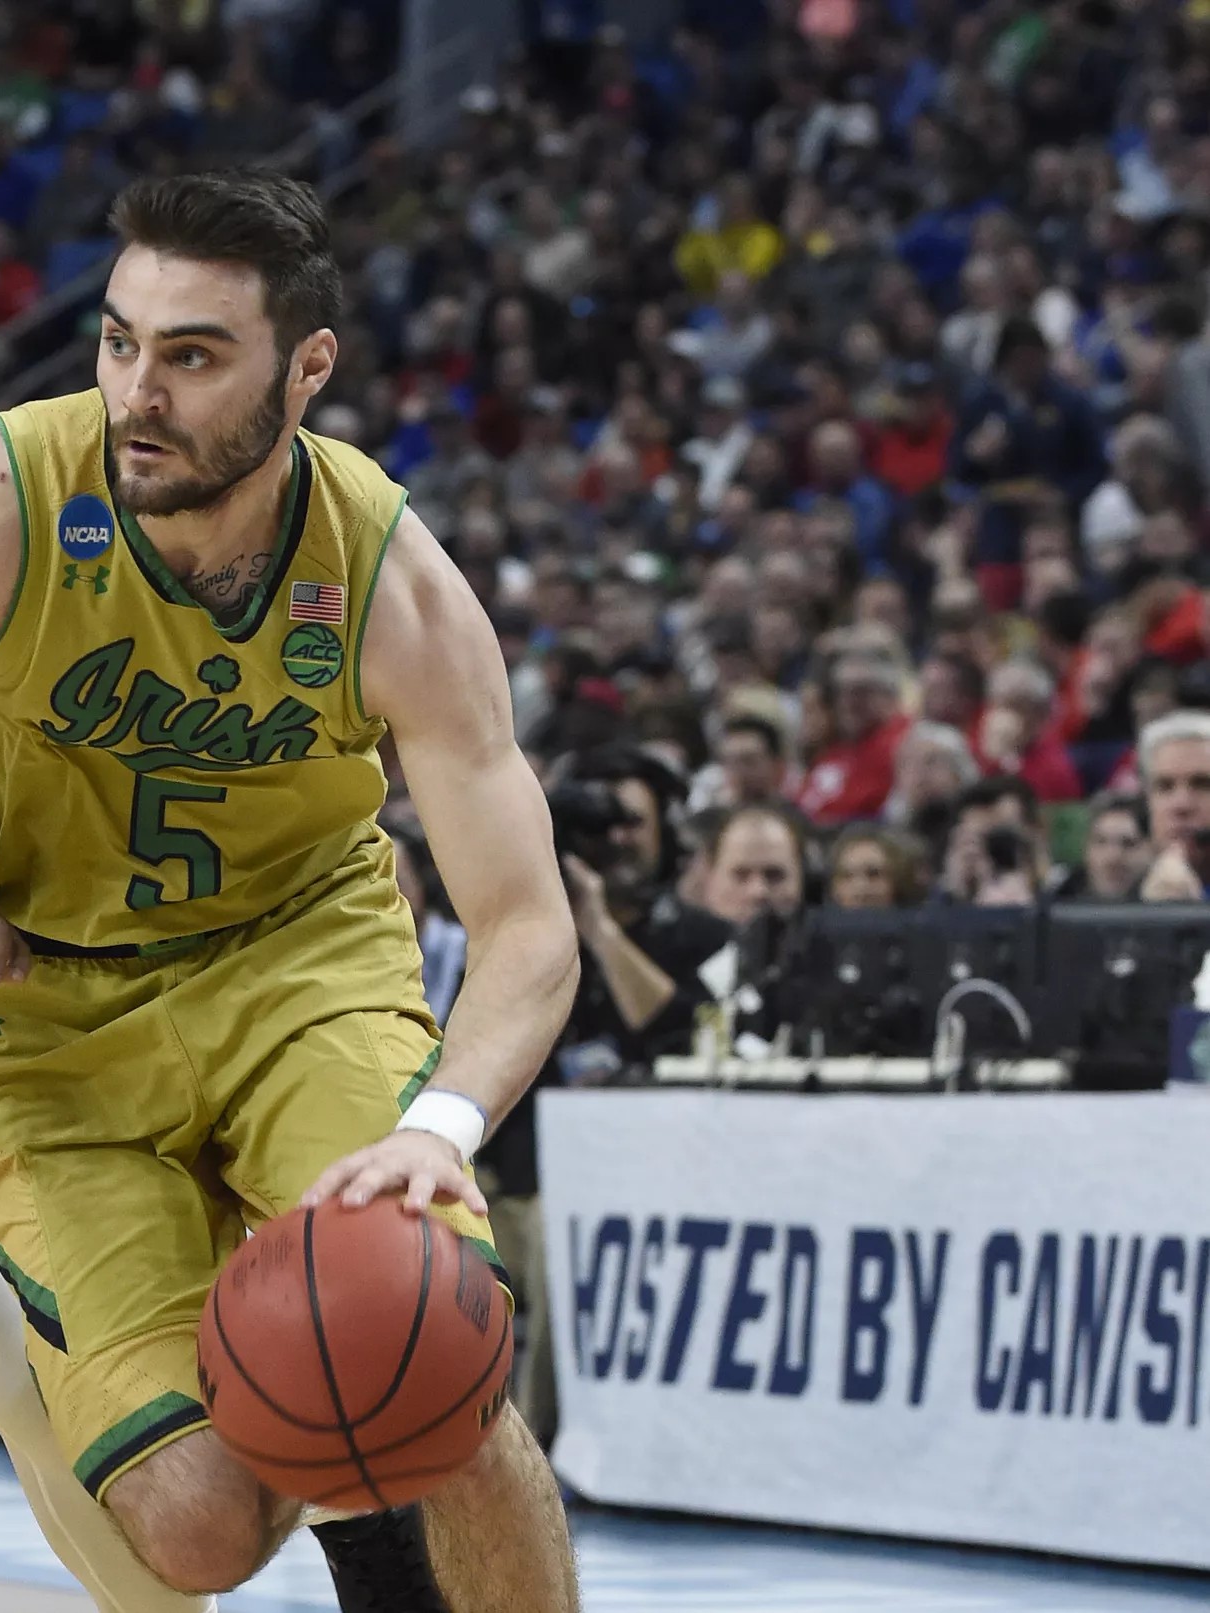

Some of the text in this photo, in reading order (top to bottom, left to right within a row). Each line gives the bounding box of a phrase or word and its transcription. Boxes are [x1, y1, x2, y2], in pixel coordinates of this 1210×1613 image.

[64, 526, 110, 544] NCAA
[40, 637, 324, 764] Irish
[125, 772, 228, 912] 5
[840, 1225, 952, 1408] BY
